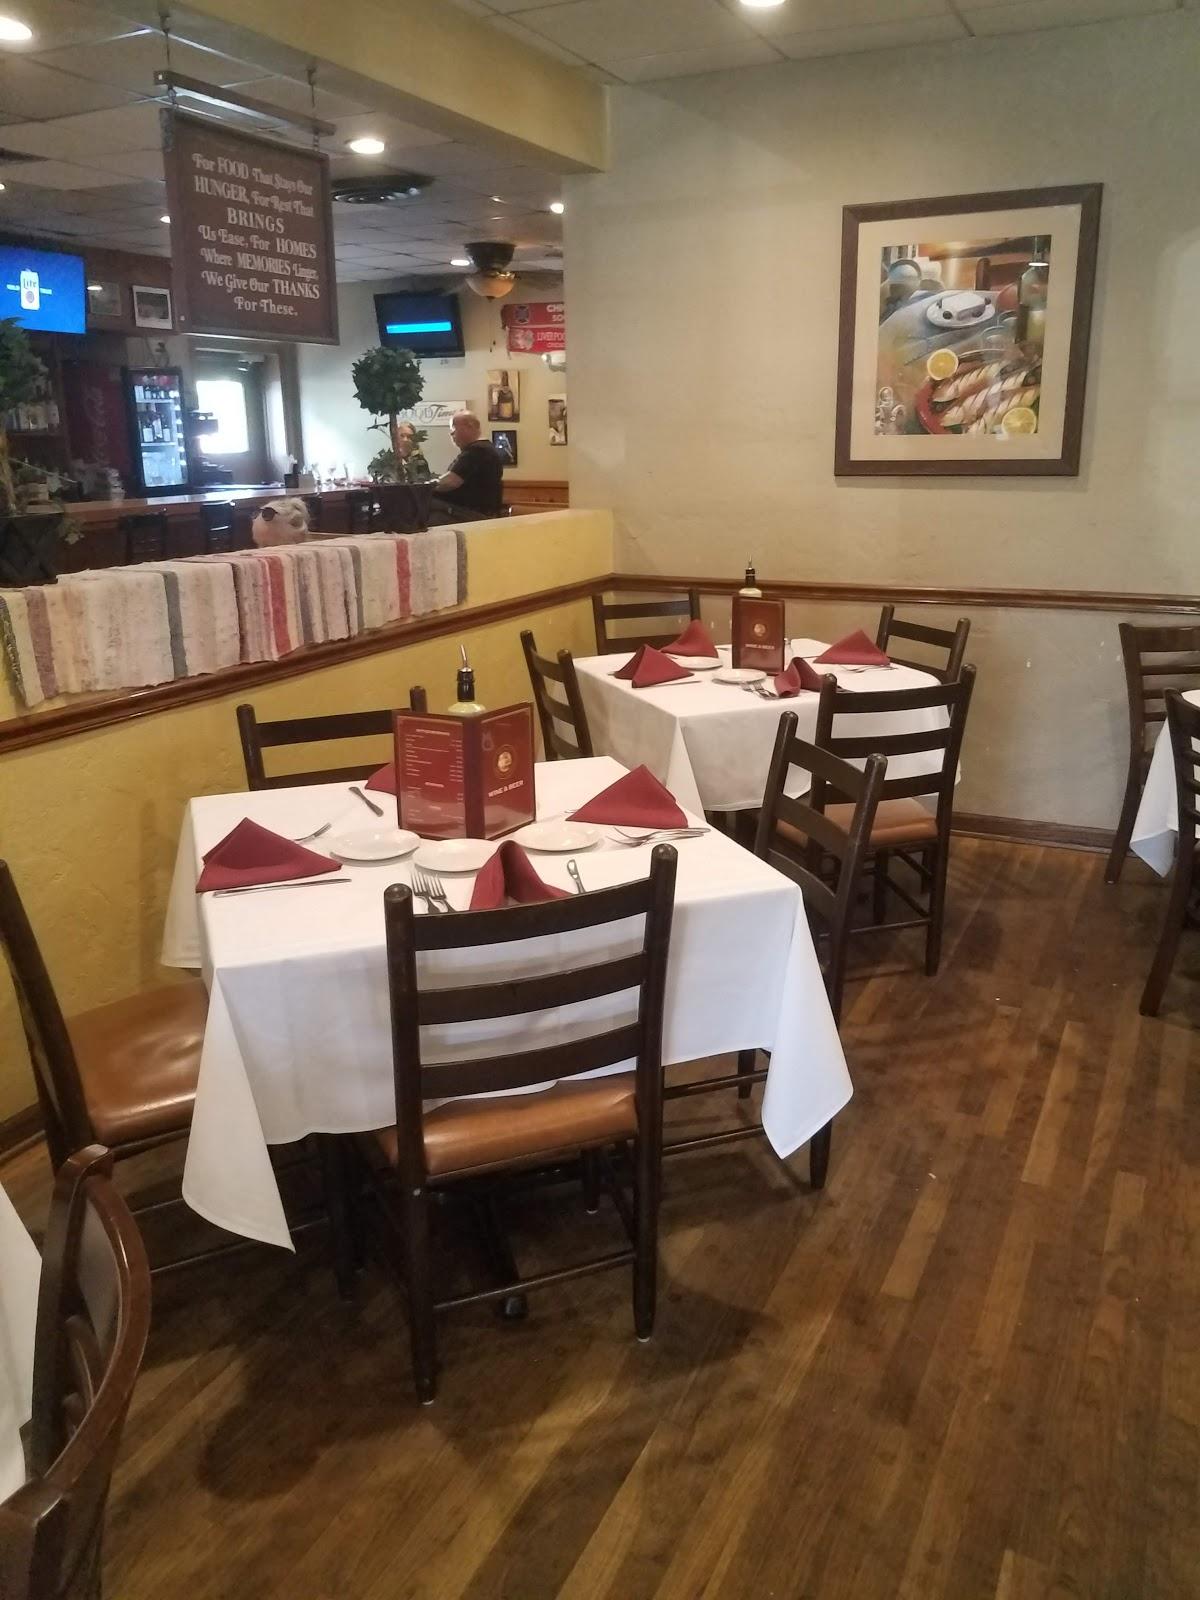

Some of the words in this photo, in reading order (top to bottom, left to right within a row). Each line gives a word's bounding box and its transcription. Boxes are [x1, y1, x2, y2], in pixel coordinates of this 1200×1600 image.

[192, 153, 215, 172] For
[217, 156, 249, 179] FOOD
[252, 168, 273, 185] That
[274, 173, 295, 193] Stays
[296, 180, 313, 195] Our
[194, 176, 250, 204] HUNGER,
[251, 190, 270, 207] For
[270, 195, 292, 212] Rest
[293, 200, 315, 217] That
[227, 207, 284, 234] BRINGS
[198, 225, 216, 241] Us
[218, 228, 249, 248] Ease,
[250, 235, 270, 251] For
[276, 238, 317, 259] HOMES
[200, 248, 233, 266] Where
[236, 252, 291, 276] MEMORIES
[201, 270, 223, 287] We
[225, 273, 248, 293] Give
[249, 278, 270, 293] Our
[272, 279, 320, 300] THANKS
[233, 296, 257, 312] For
[260, 299, 298, 317] These.
